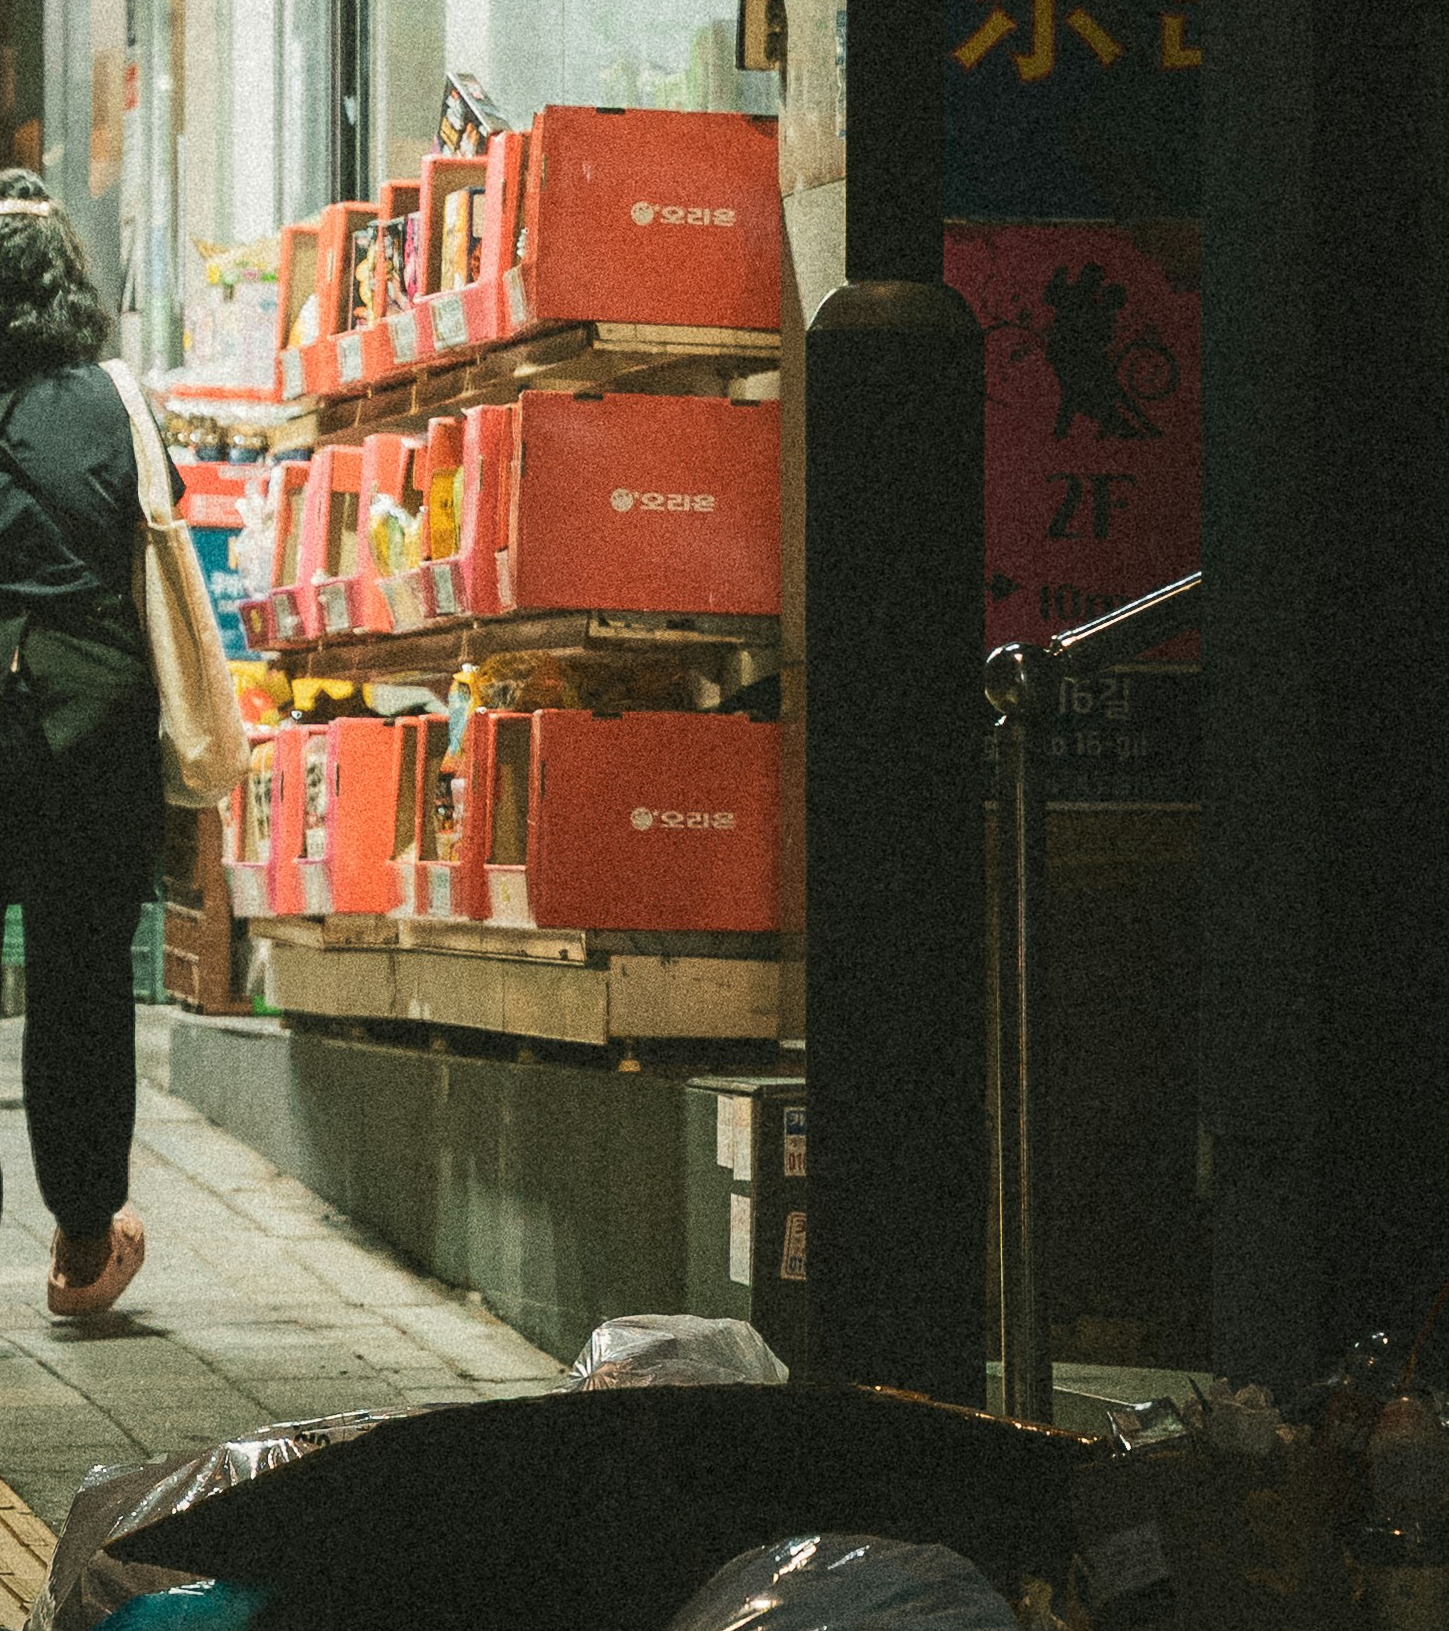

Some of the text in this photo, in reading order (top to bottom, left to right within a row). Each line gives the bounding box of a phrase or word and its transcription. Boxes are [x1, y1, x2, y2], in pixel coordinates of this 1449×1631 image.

[659, 205, 736, 228] 오리온
[640, 491, 716, 514] 오리온
[1045, 472, 1138, 540] 2F
[659, 810, 738, 833] 오리온
